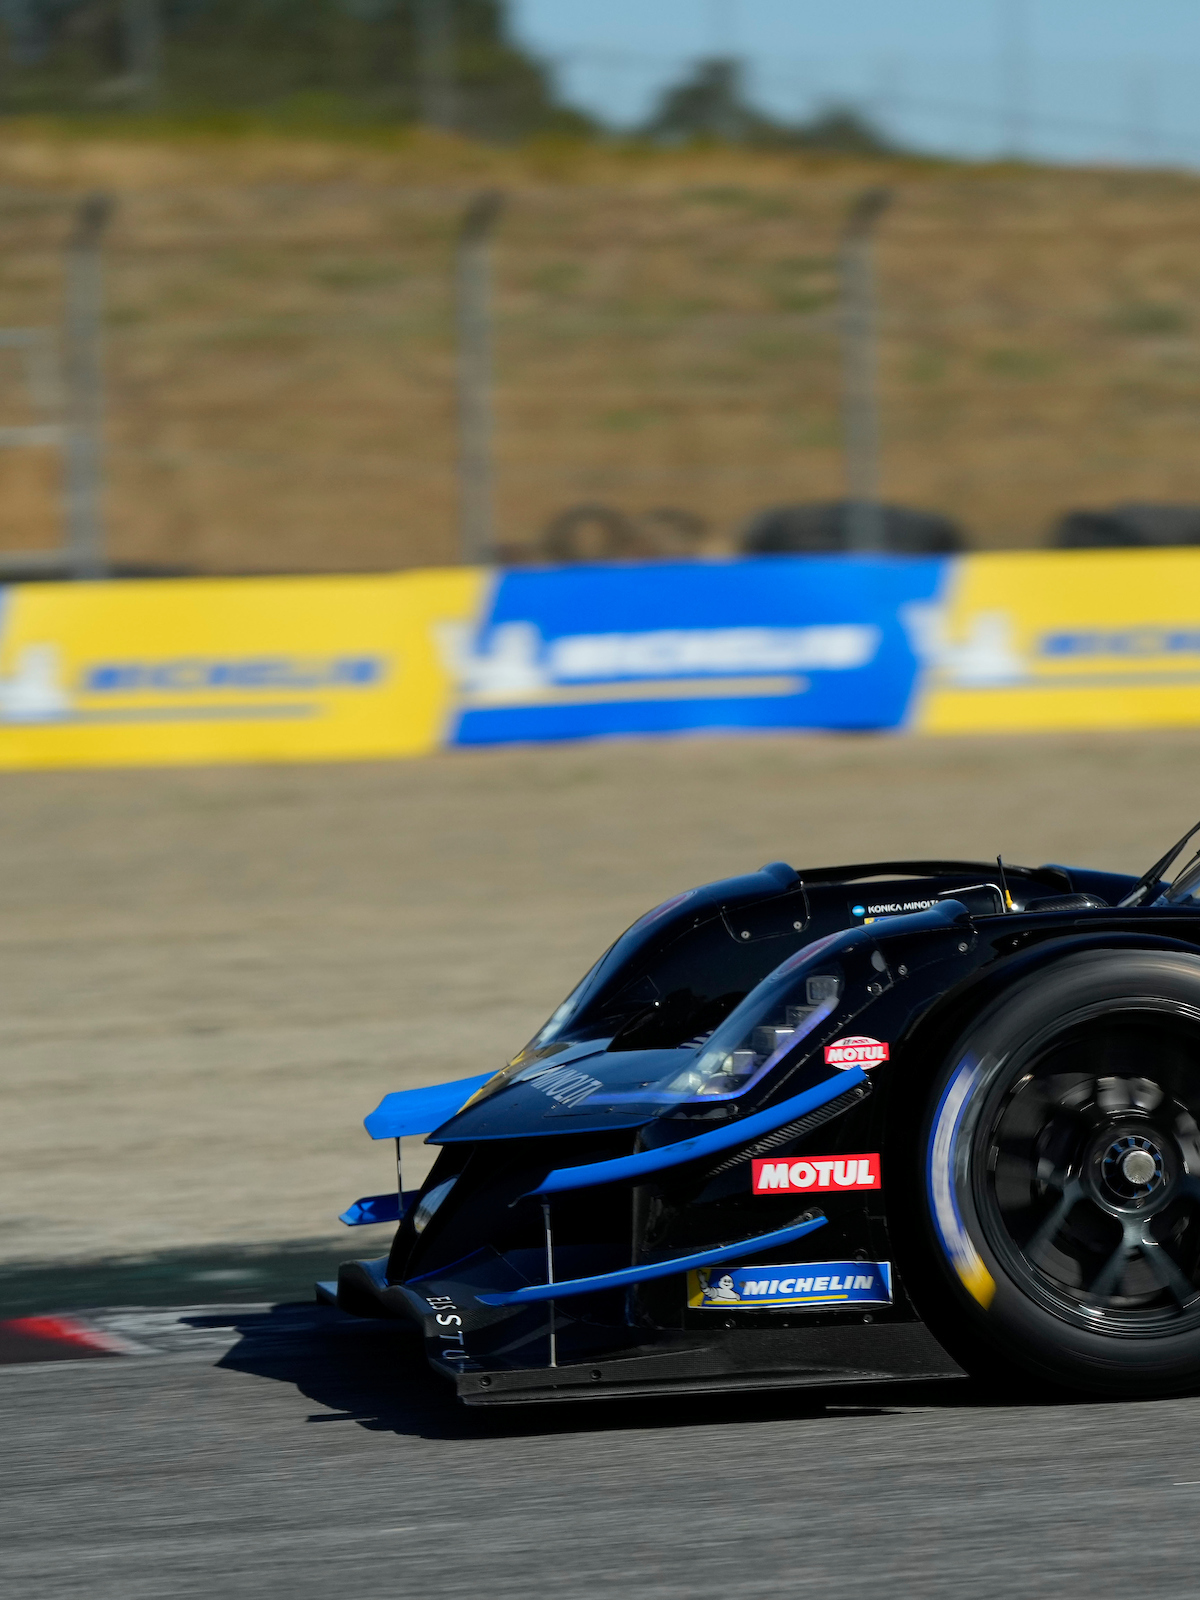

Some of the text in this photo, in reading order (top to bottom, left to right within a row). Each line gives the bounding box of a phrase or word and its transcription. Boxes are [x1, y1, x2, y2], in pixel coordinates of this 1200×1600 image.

[867, 903, 901, 914] KONICA
[827, 1046, 887, 1062] MOTUL
[757, 1159, 876, 1189] MOTUL
[742, 1275, 874, 1296] MICHELIN
